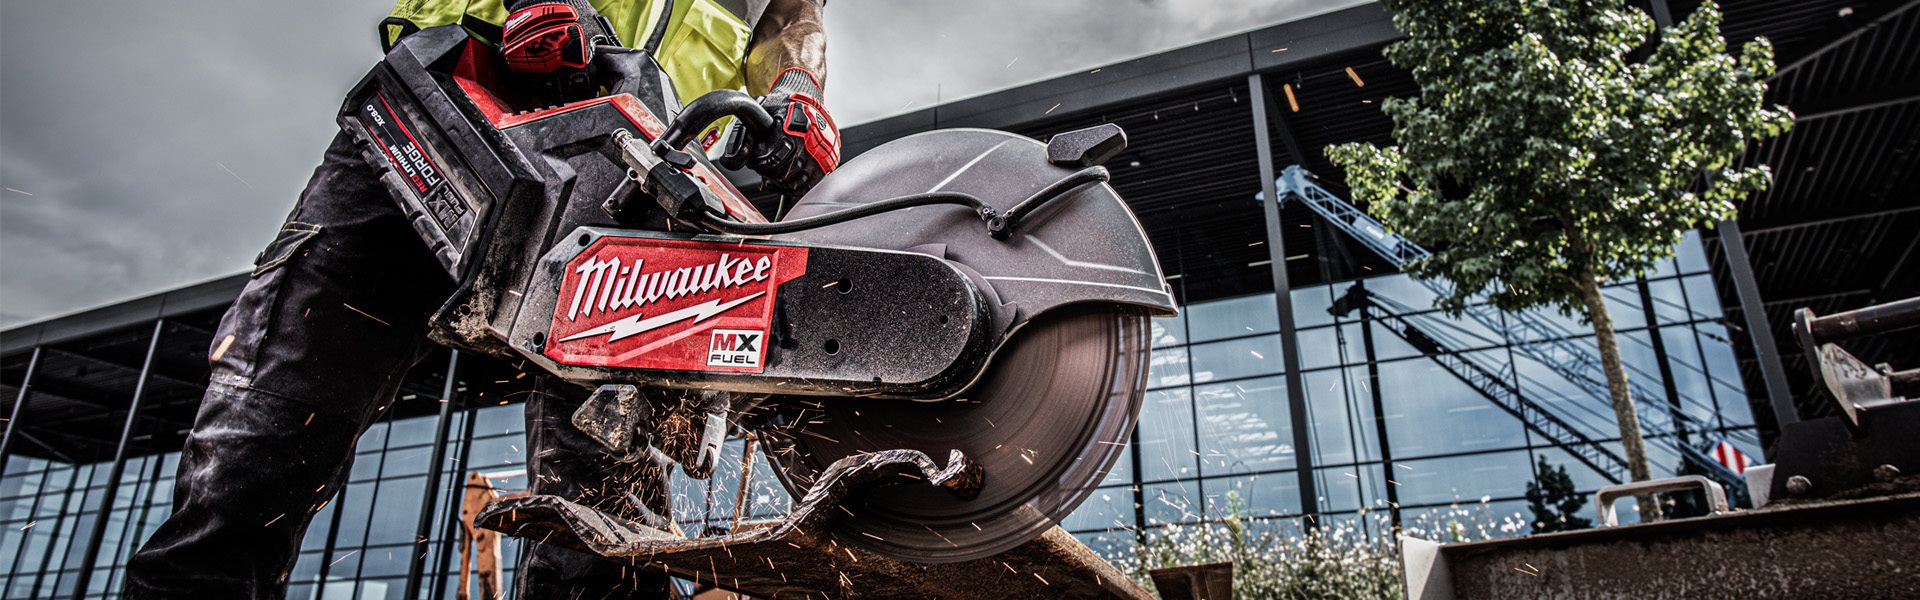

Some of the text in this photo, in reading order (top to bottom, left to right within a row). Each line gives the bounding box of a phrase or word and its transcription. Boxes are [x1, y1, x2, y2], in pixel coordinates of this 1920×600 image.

[366, 104, 386, 126] XC8.0
[402, 141, 440, 186] FORGE
[568, 253, 771, 321] Milwaukee
[713, 333, 759, 352] MX
[710, 354, 756, 364] FUEL
